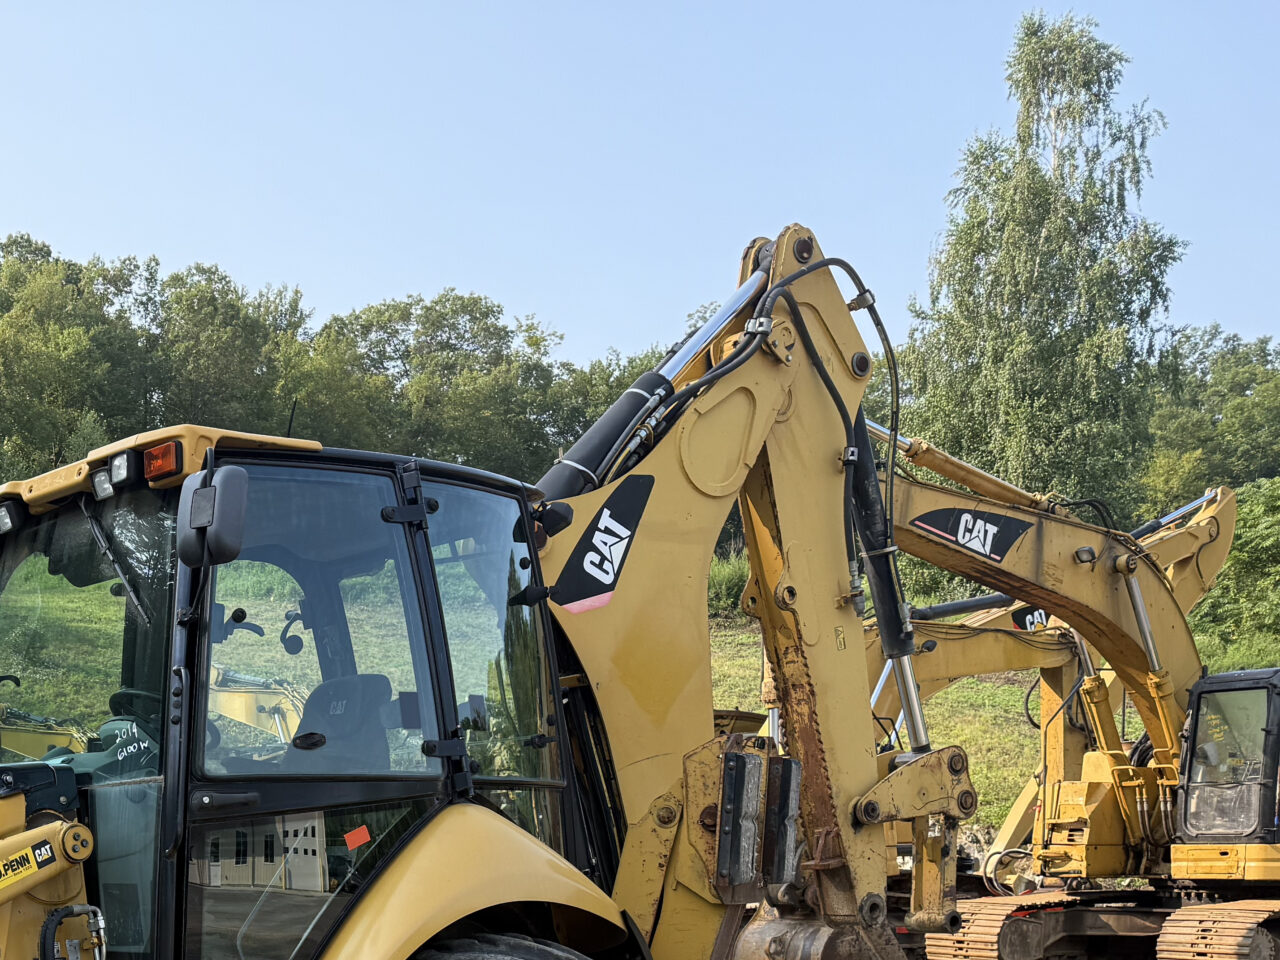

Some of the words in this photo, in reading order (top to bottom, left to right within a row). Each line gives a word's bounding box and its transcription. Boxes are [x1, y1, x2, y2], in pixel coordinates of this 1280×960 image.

[957, 512, 999, 556] CAT
[583, 508, 632, 585] CAT
[1025, 608, 1047, 632] CAT
[329, 700, 348, 714] CAT
[34, 843, 53, 863] CAT
